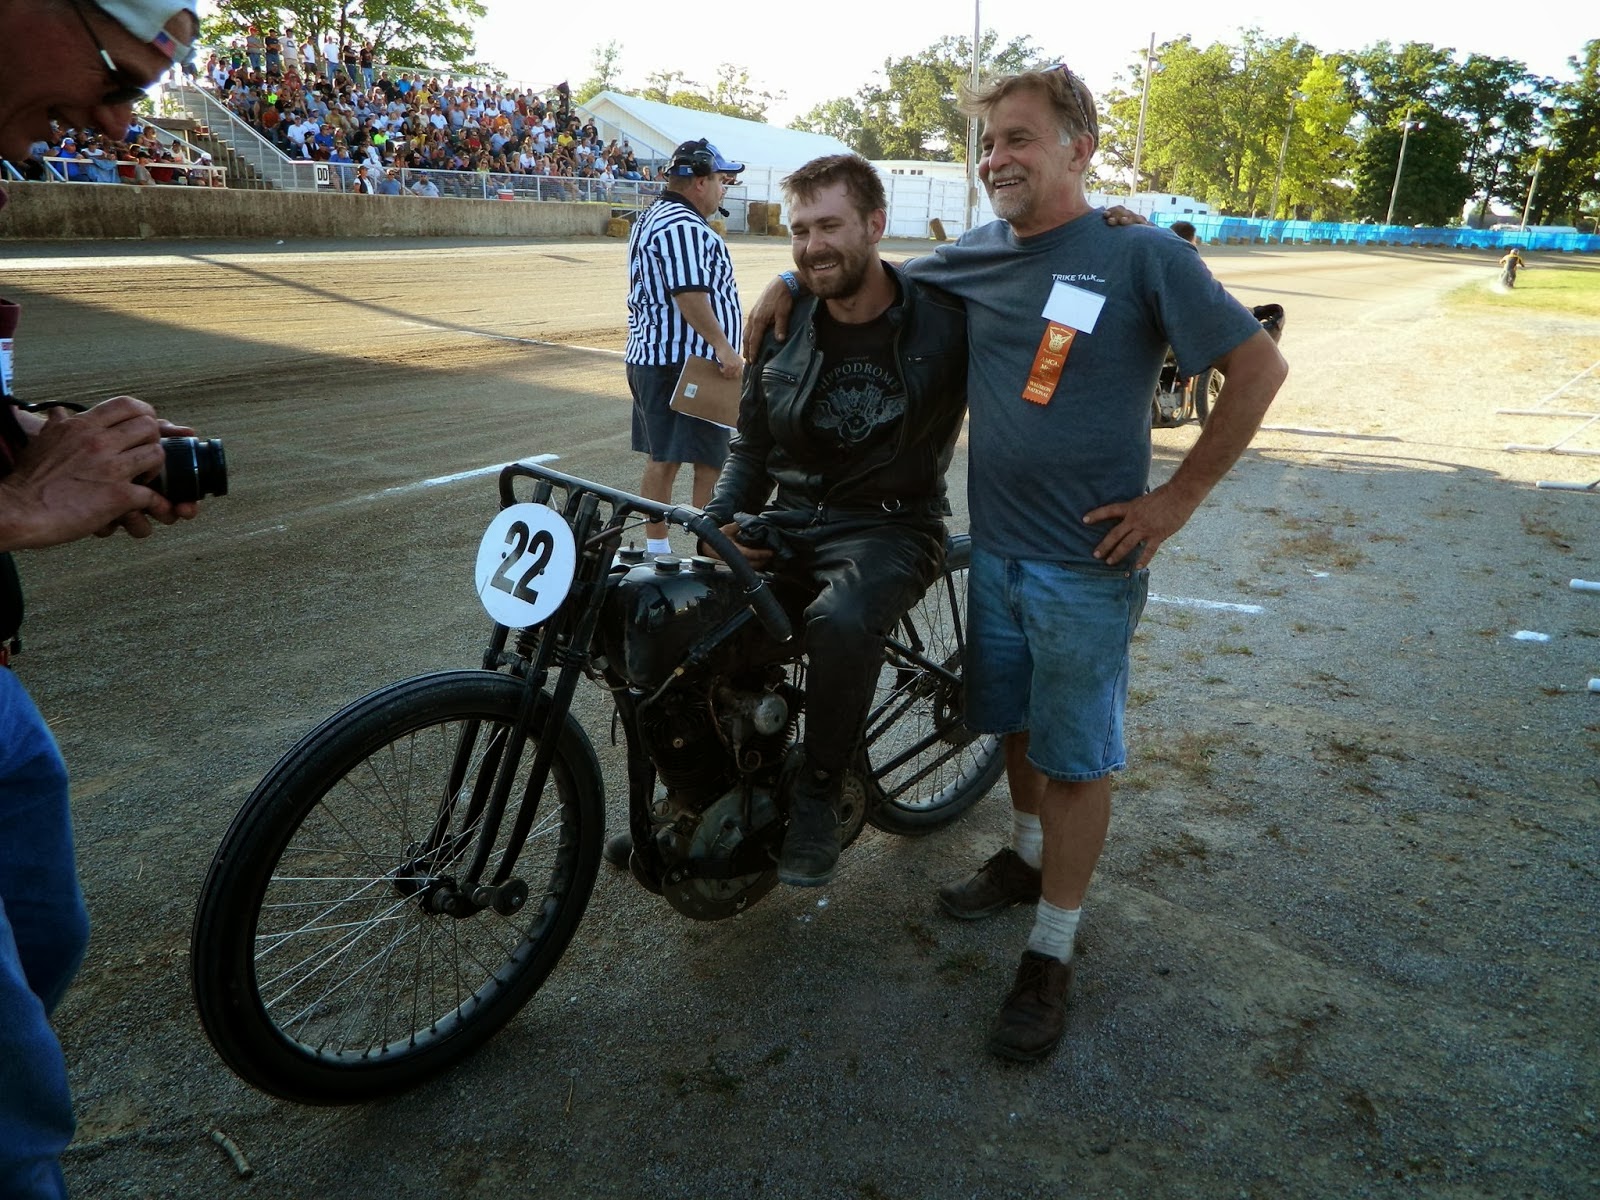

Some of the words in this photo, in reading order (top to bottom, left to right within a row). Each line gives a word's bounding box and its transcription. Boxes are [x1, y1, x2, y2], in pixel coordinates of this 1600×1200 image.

[317, 167, 328, 181] DD
[1052, 273, 1077, 281] TRIKE
[490, 520, 554, 606] 22
